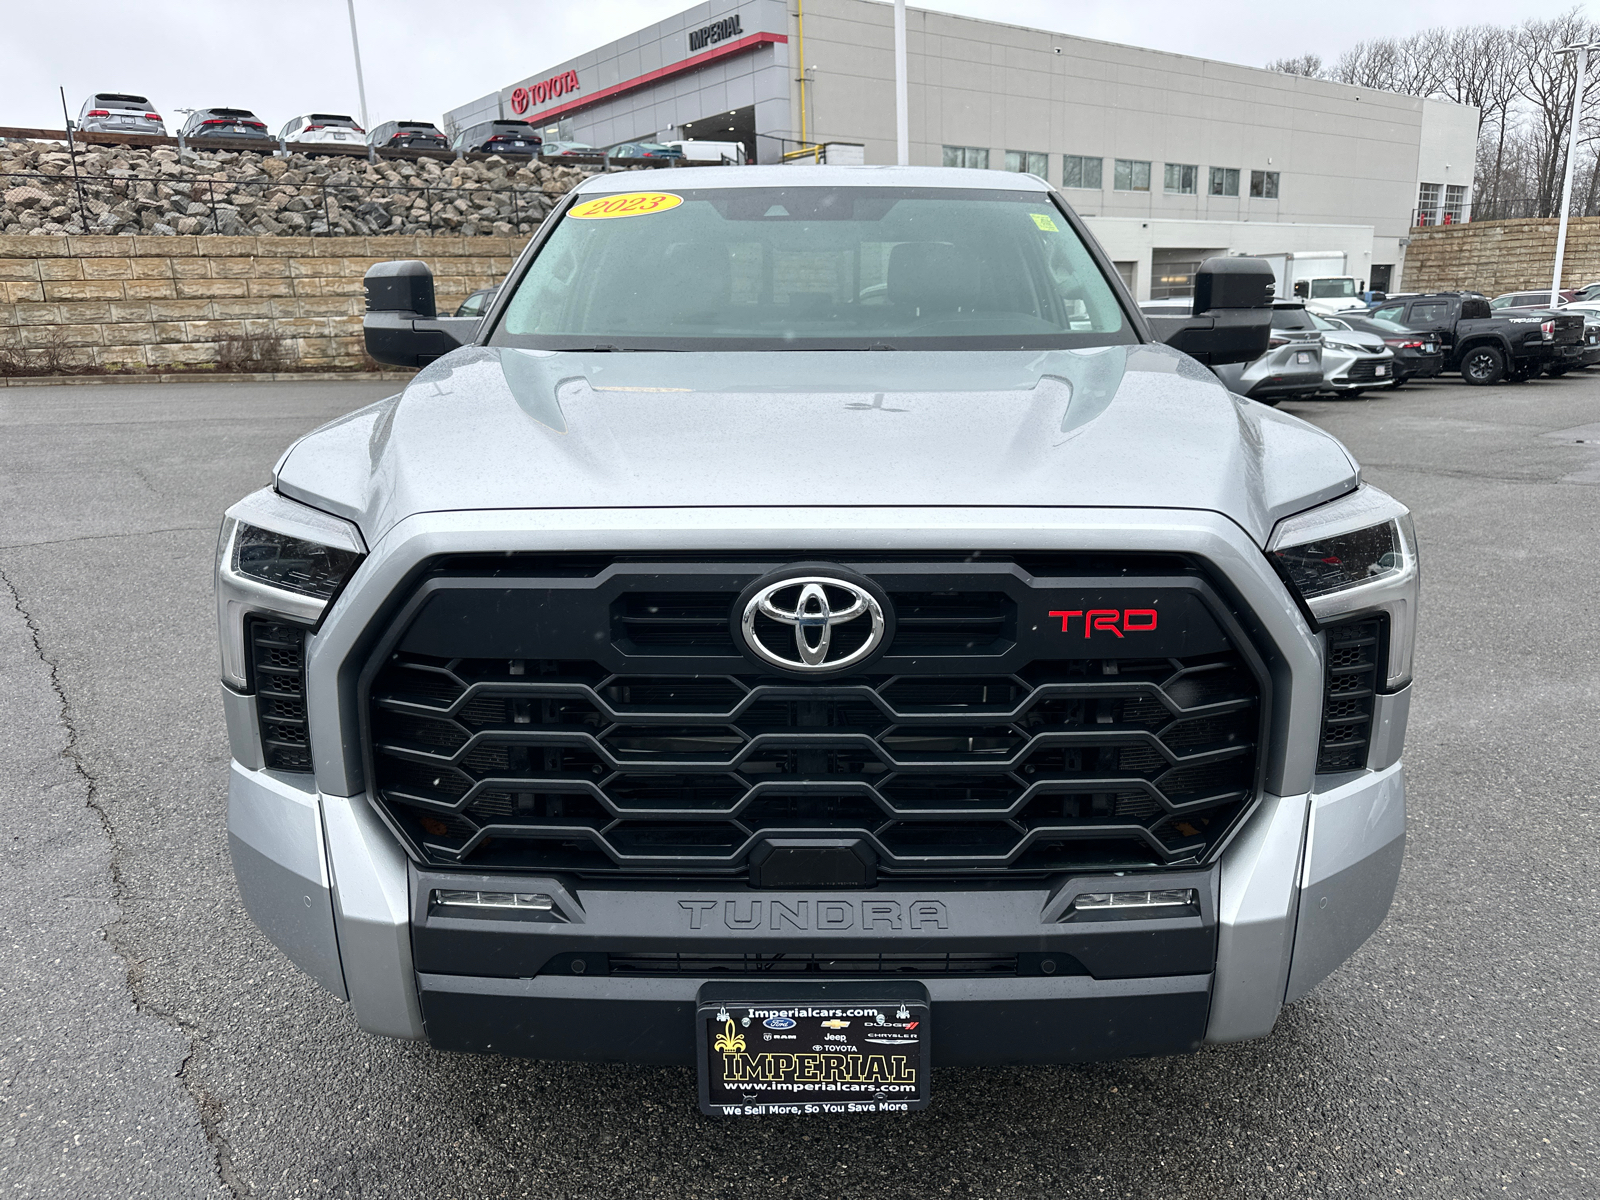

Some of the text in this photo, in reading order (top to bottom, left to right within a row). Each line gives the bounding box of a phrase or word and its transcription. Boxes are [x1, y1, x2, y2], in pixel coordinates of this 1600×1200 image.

[689, 14, 743, 51] IMPERIAL
[528, 69, 580, 106] TOYOTA
[583, 196, 666, 216] 2023
[1048, 608, 1158, 639] TRD
[677, 900, 949, 931] TUNDRA
[748, 1007, 878, 1019] Imperialcars.com
[824, 1033, 847, 1042] Jeep
[723, 1053, 916, 1083] IMPERIAL
[723, 1082, 916, 1093] www.imperialcars.com
[722, 1102, 908, 1116] We Sell More, So You Save More
